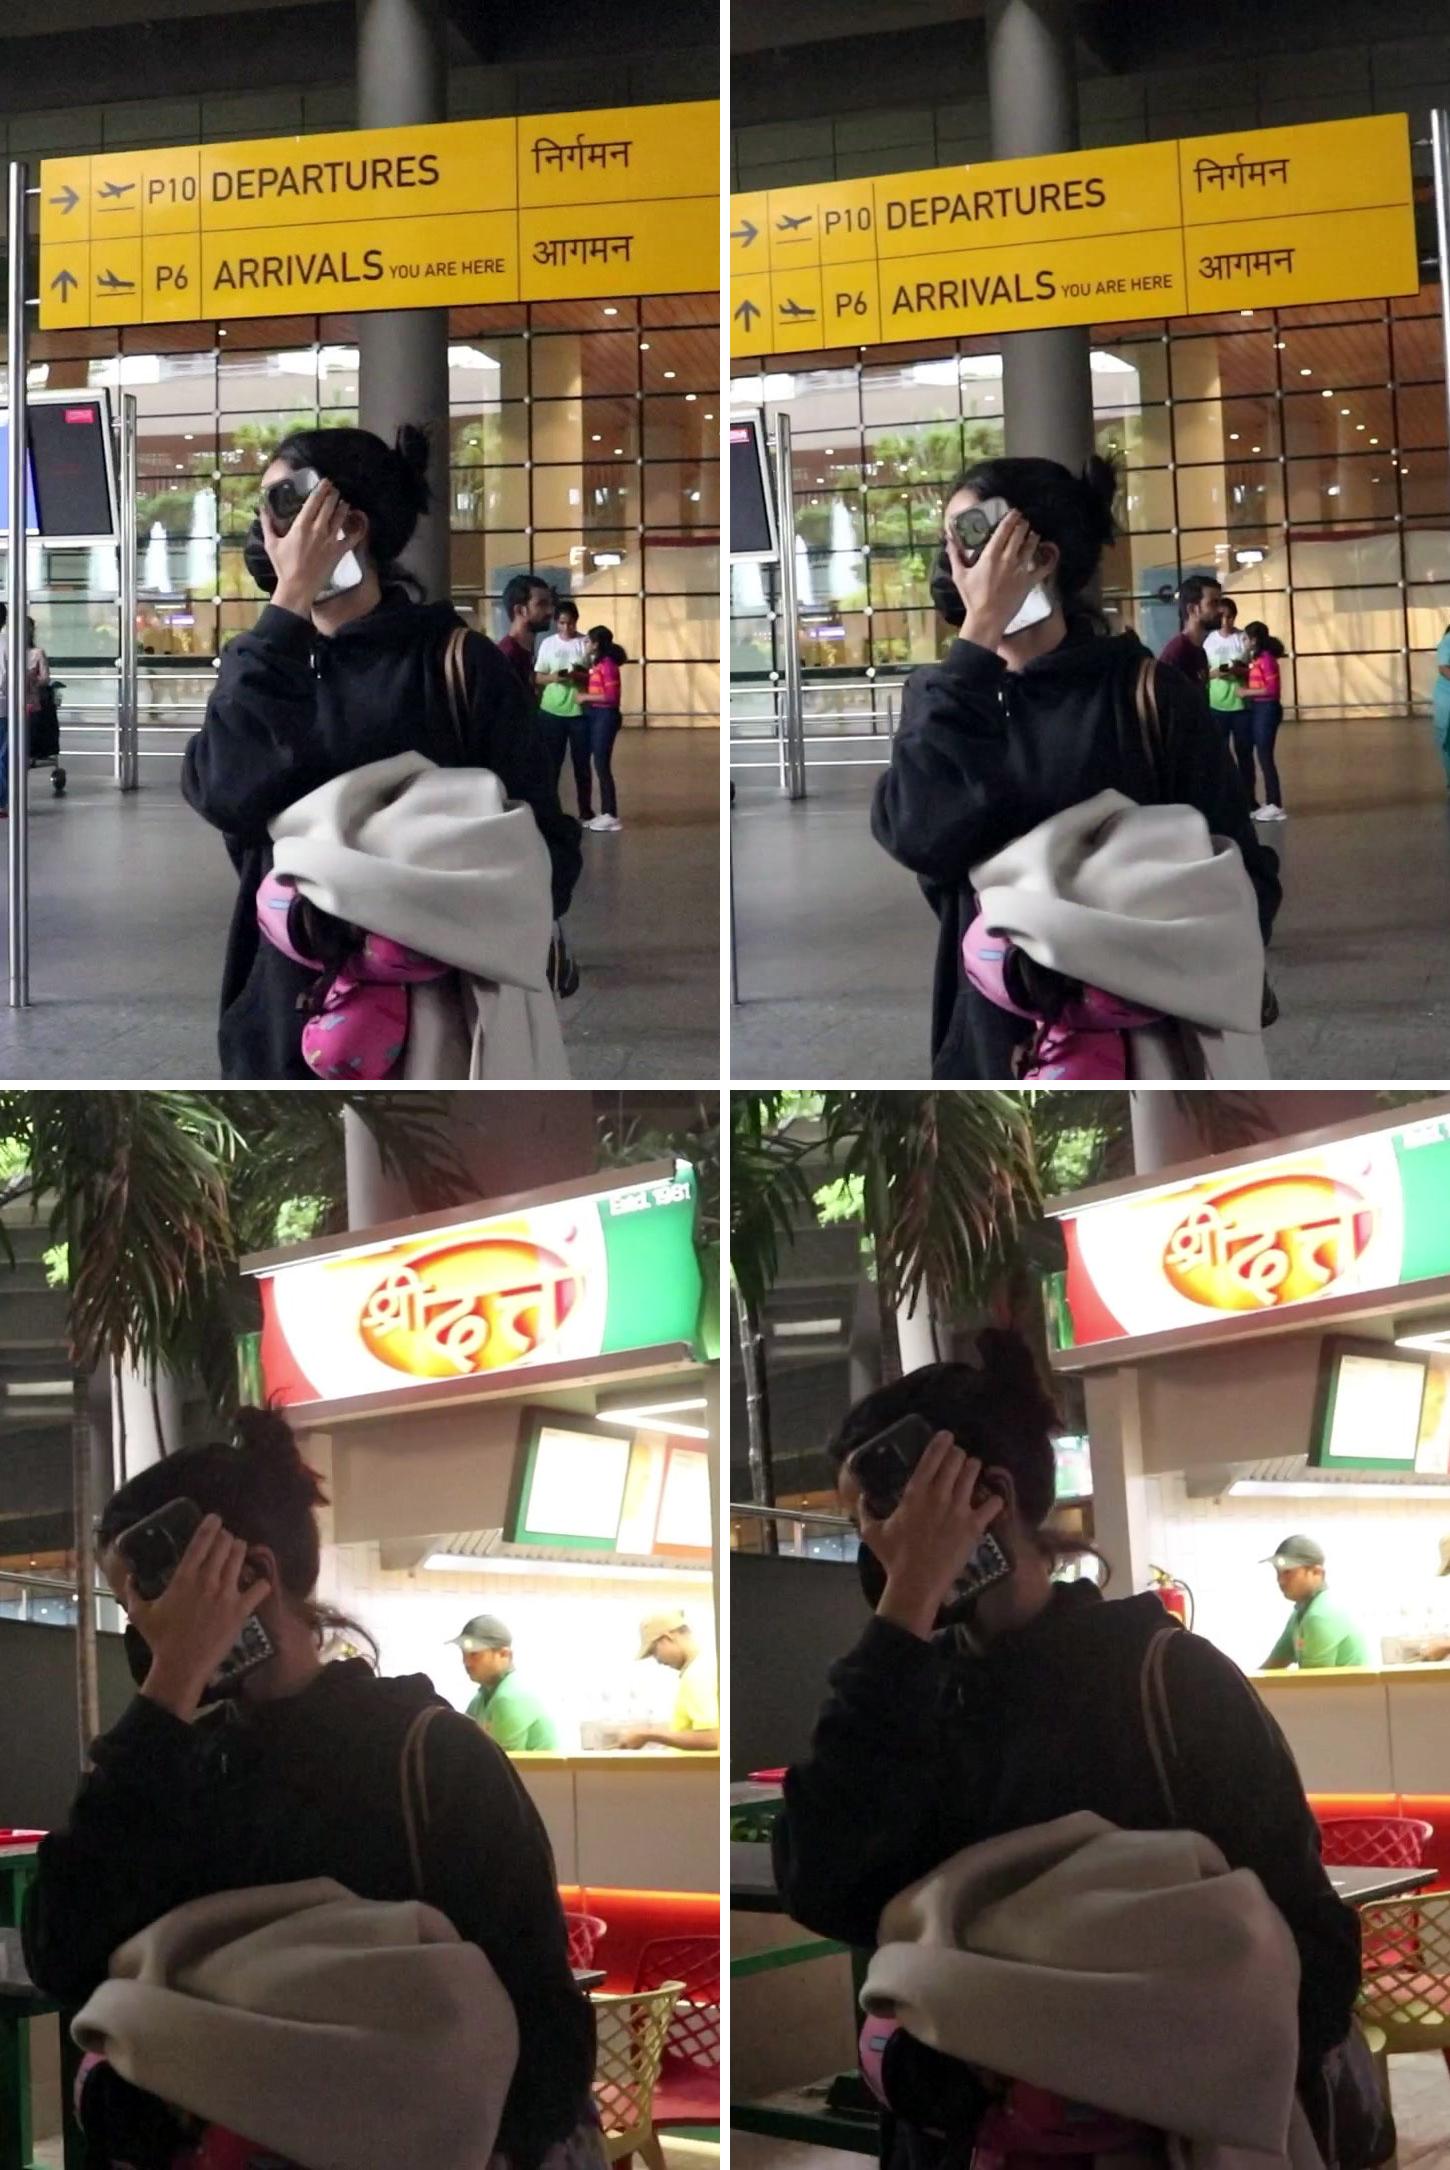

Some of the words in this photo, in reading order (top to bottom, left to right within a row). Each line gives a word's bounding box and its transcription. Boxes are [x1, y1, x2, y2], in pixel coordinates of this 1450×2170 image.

[531, 132, 634, 174] निर्गमन
[1192, 152, 1291, 194] निर्गमन
[149, 176, 197, 205] P10
[211, 154, 440, 202] DEPARTURES
[824, 206, 872, 235] P10
[886, 177, 1107, 231] DEPARTURES
[155, 264, 189, 292] P6
[213, 249, 385, 292] ARRIVALS
[389, 264, 420, 279] YOU
[424, 261, 457, 277] ARE
[461, 258, 506, 275] HERE
[531, 235, 635, 267] आगमन
[1197, 248, 1296, 281] आगमन
[835, 291, 868, 318] P6
[891, 270, 1057, 316] ARRIVALS
[1061, 283, 1092, 299] YOU
[1095, 278, 1126, 295] ARE
[1131, 273, 1174, 292] HERE
